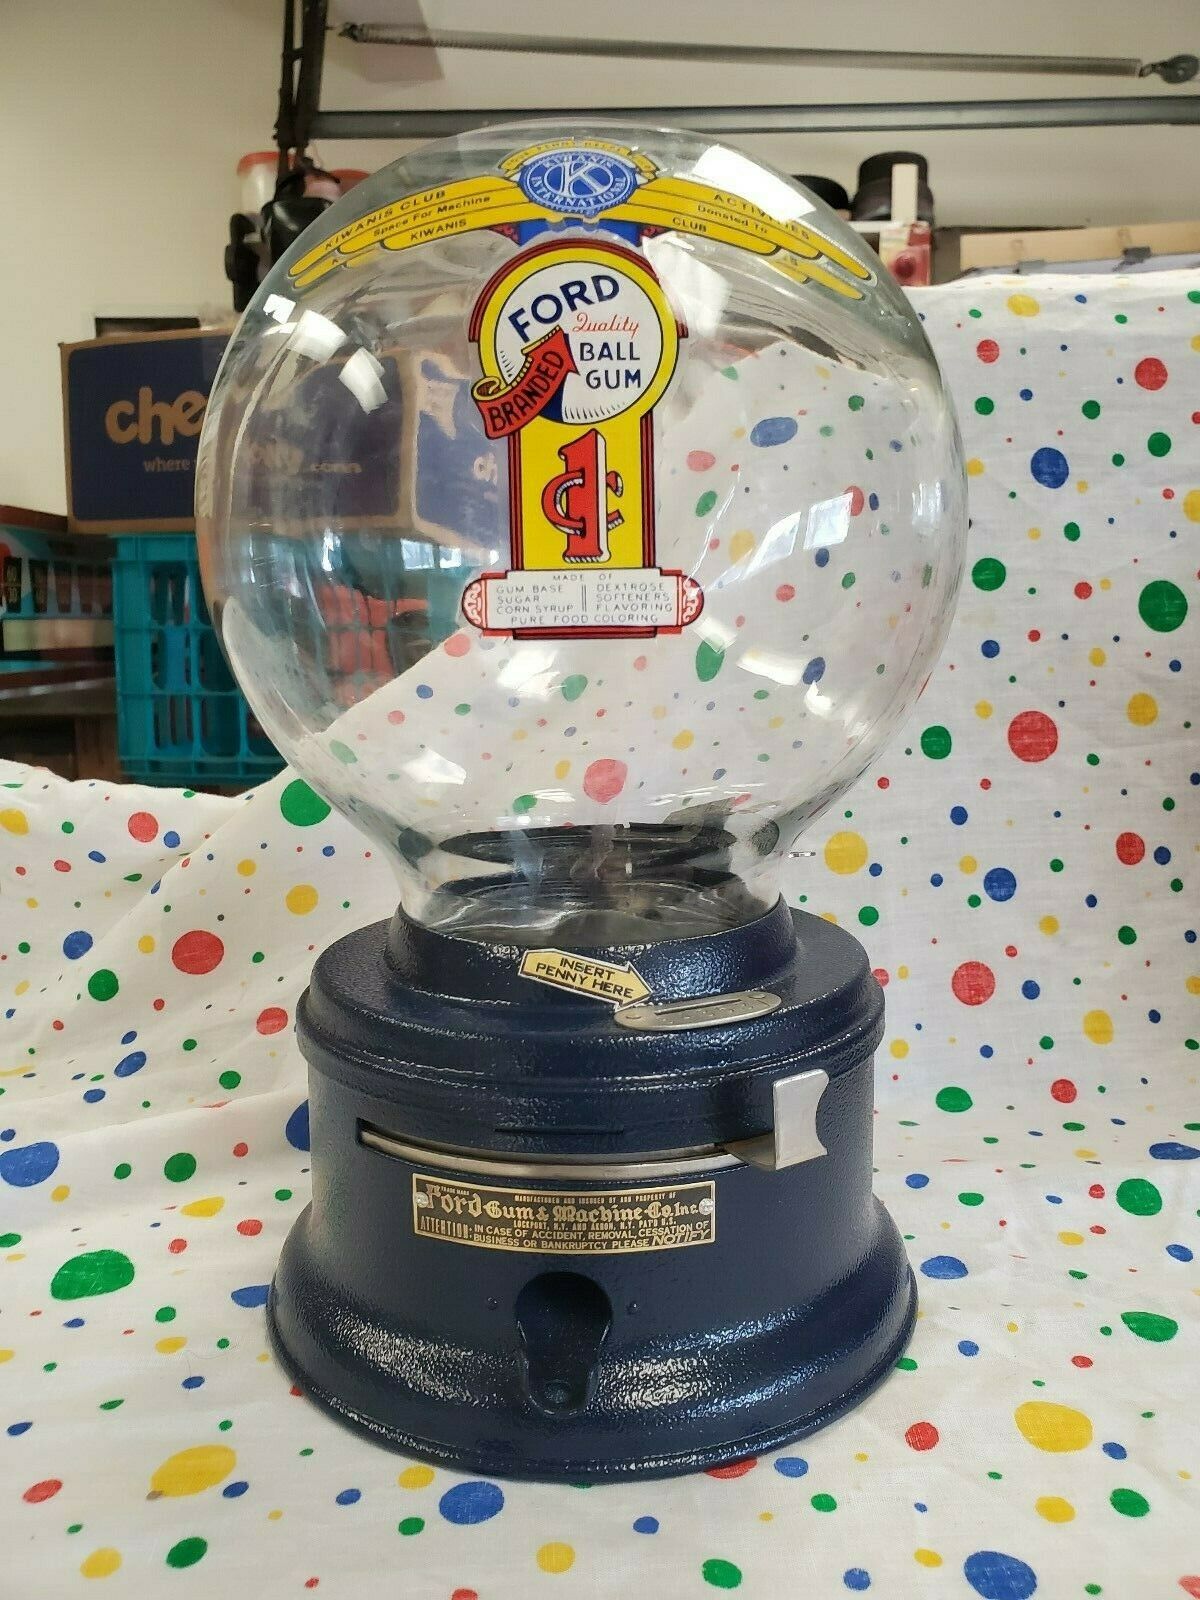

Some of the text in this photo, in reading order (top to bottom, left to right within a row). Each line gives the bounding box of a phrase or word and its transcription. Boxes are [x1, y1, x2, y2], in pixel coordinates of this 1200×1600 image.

[325, 190, 446, 250] KIWANIS CLUB
[373, 197, 491, 237] Space For Machine
[672, 216, 708, 233] CLUB
[697, 204, 749, 227] Donated
[410, 218, 468, 242] KIWANIS
[508, 275, 620, 343] FORD
[572, 312, 639, 340] Quality
[579, 341, 641, 362] BALL
[585, 368, 642, 390] GUM
[487, 350, 565, 433] BRANDED
[105, 386, 209, 446] che
[144, 457, 191, 472] where
[553, 573, 613, 582] MADE OF
[596, 582, 665, 593] DEXTROSE
[496, 584, 564, 595] GUM BASE
[497, 595, 540, 605] SUGAR
[596, 592, 670, 603] SOFTENERS
[496, 604, 574, 615] CORN SYRUP
[596, 602, 673, 613] FLAVORING
[511, 613, 658, 626] PURE FOOD COLORING
[536, 961, 635, 998] PENNY HERE
[558, 957, 616, 980] INSERT
[425, 1183, 482, 1218] Ford
[552, 1203, 643, 1222] Machine
[474, 1223, 484, 1233] IN
[486, 1225, 513, 1237] CASE
[515, 1228, 529, 1238] OF
[532, 1230, 586, 1242] ACCIDENT,
[588, 1230, 638, 1240] REMOVAL,
[638, 1222, 693, 1238] CESSATION
[696, 1220, 710, 1230] OF
[513, 1219, 550, 1230] LOCKPORT,
[572, 1222, 587, 1231] AND
[473, 1228, 711, 1250] BUSINESS OR BANKRUPTCY PLEASE NOTIFY
